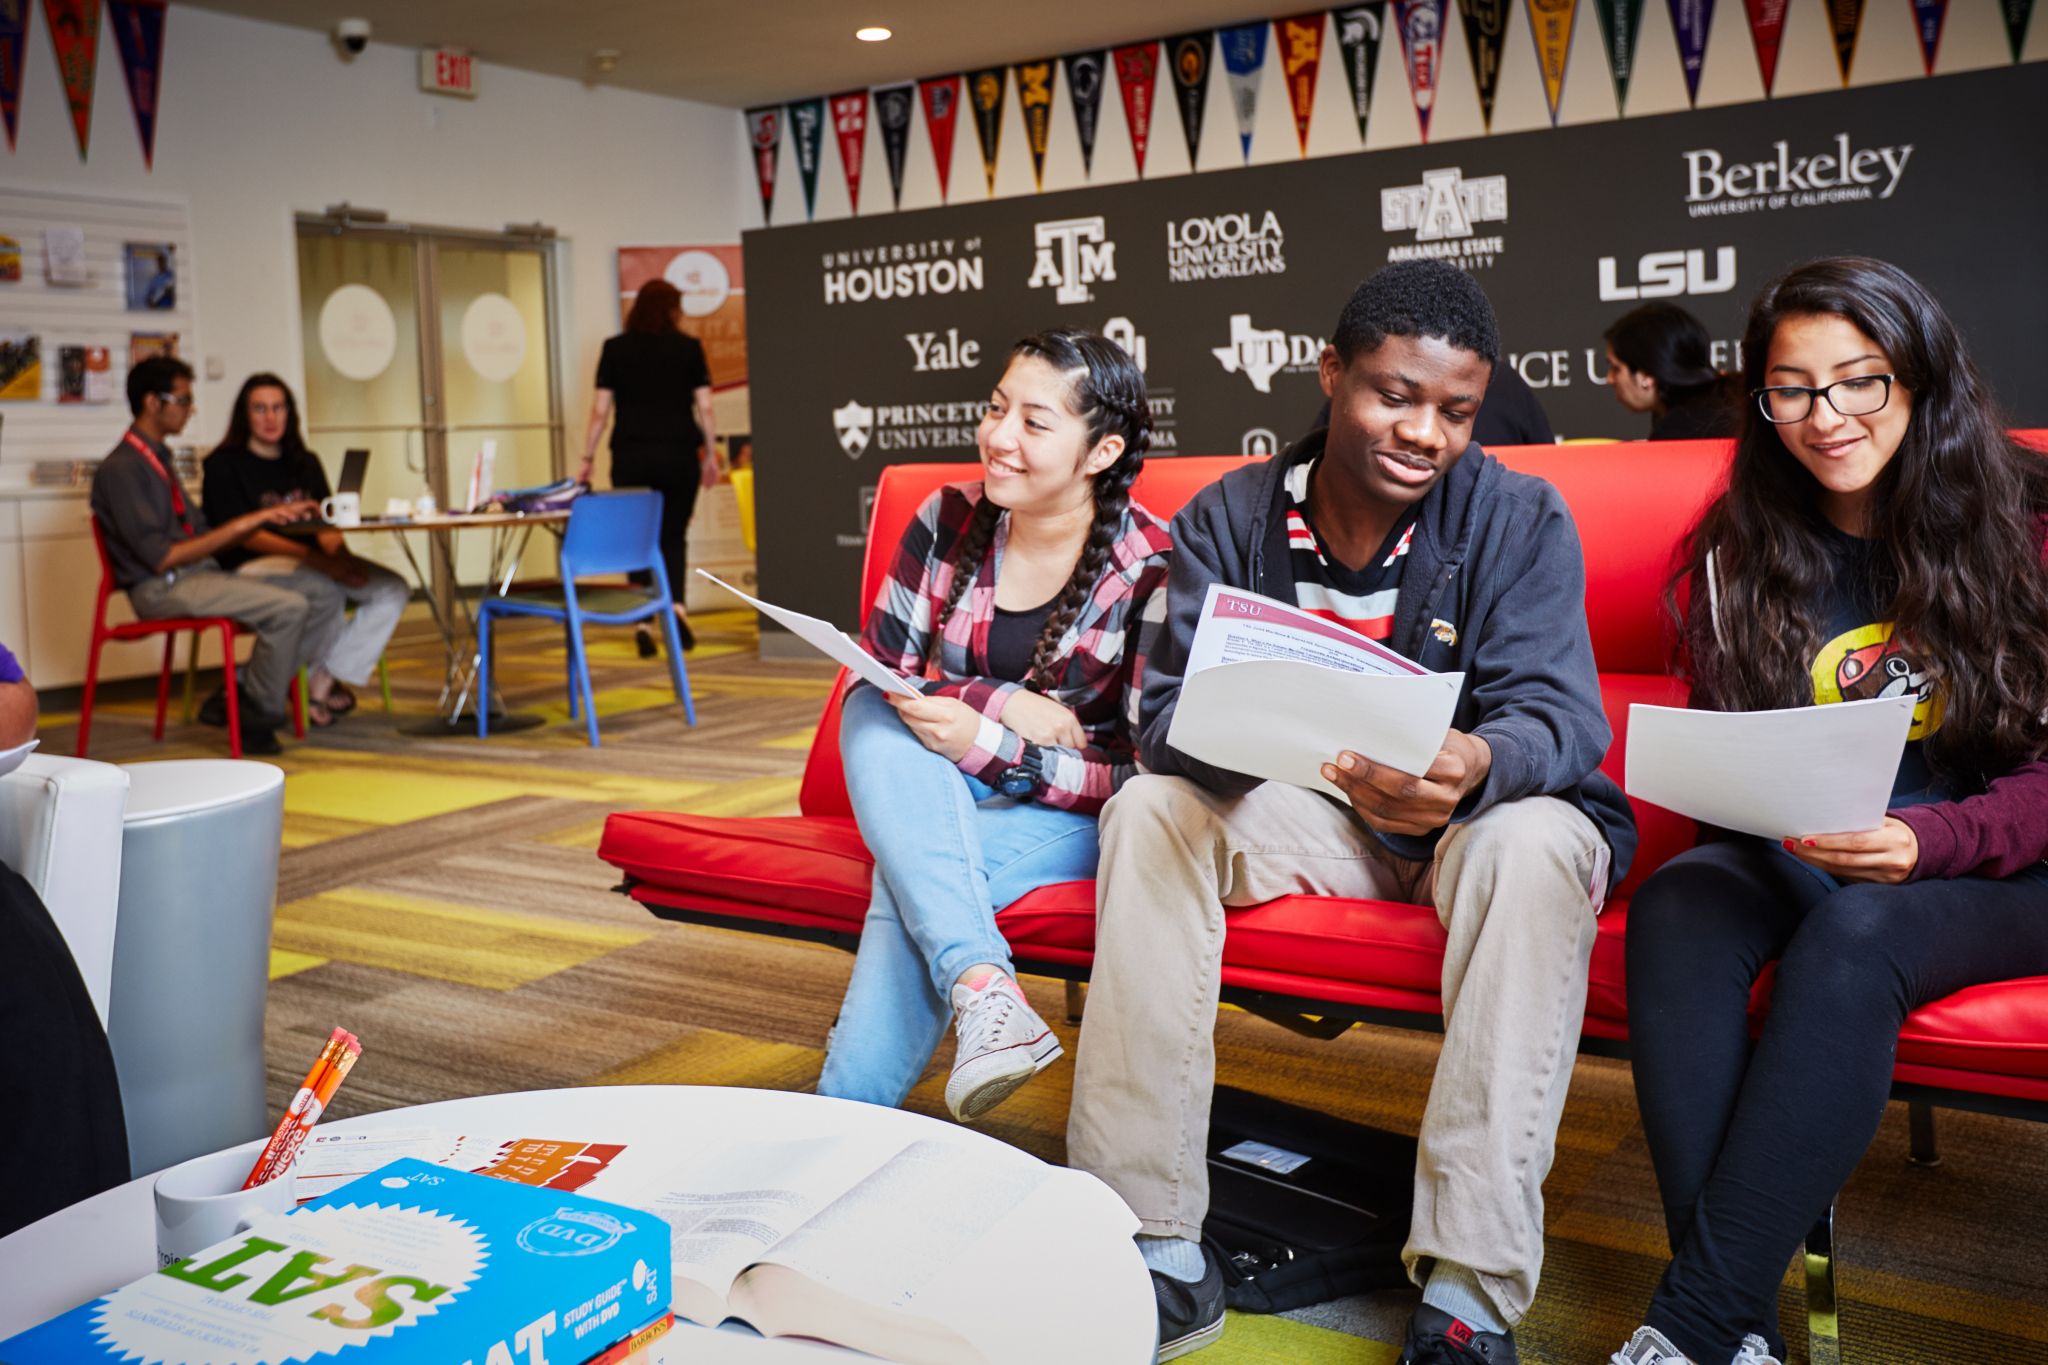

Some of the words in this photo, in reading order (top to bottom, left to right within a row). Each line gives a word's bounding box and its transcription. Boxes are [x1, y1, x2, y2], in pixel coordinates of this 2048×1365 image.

[435, 50, 472, 91] EXIT
[1682, 132, 1915, 203] Berkeley
[1688, 198, 1765, 218] UNIVERSITY
[1768, 195, 1788, 210] OF
[1791, 186, 1873, 208] CALIFORNIA
[1166, 210, 1284, 249] LOYOLA
[822, 239, 955, 269] UNIVERSITY
[964, 236, 982, 251] of
[1168, 237, 1284, 268] UNIVERSITY
[1387, 240, 1460, 263] ARKANSAS
[1462, 236, 1504, 257] STATE
[823, 256, 984, 305] HOUSTON
[1169, 264, 1207, 282] NEW
[1207, 256, 1286, 280] ORLEANS
[1598, 246, 1737, 301] LSU
[904, 327, 981, 372] Yale
[876, 400, 990, 426] PRINCETO
[877, 425, 979, 450] UNIVERSI
[1225, 598, 1263, 617] TSU
[270, 1116, 293, 1152] HOUSTON
[266, 1128, 307, 1183] ollege
[407, 1172, 446, 1186] SAT
[538, 1223, 602, 1247] DVD
[158, 1236, 452, 1329] SAT
[645, 1267, 658, 1305] SAT
[563, 1299, 594, 1329] STUDY
[574, 1315, 600, 1341] WITH
[600, 1302, 621, 1325] DVD
[461, 1310, 557, 1365] AT
